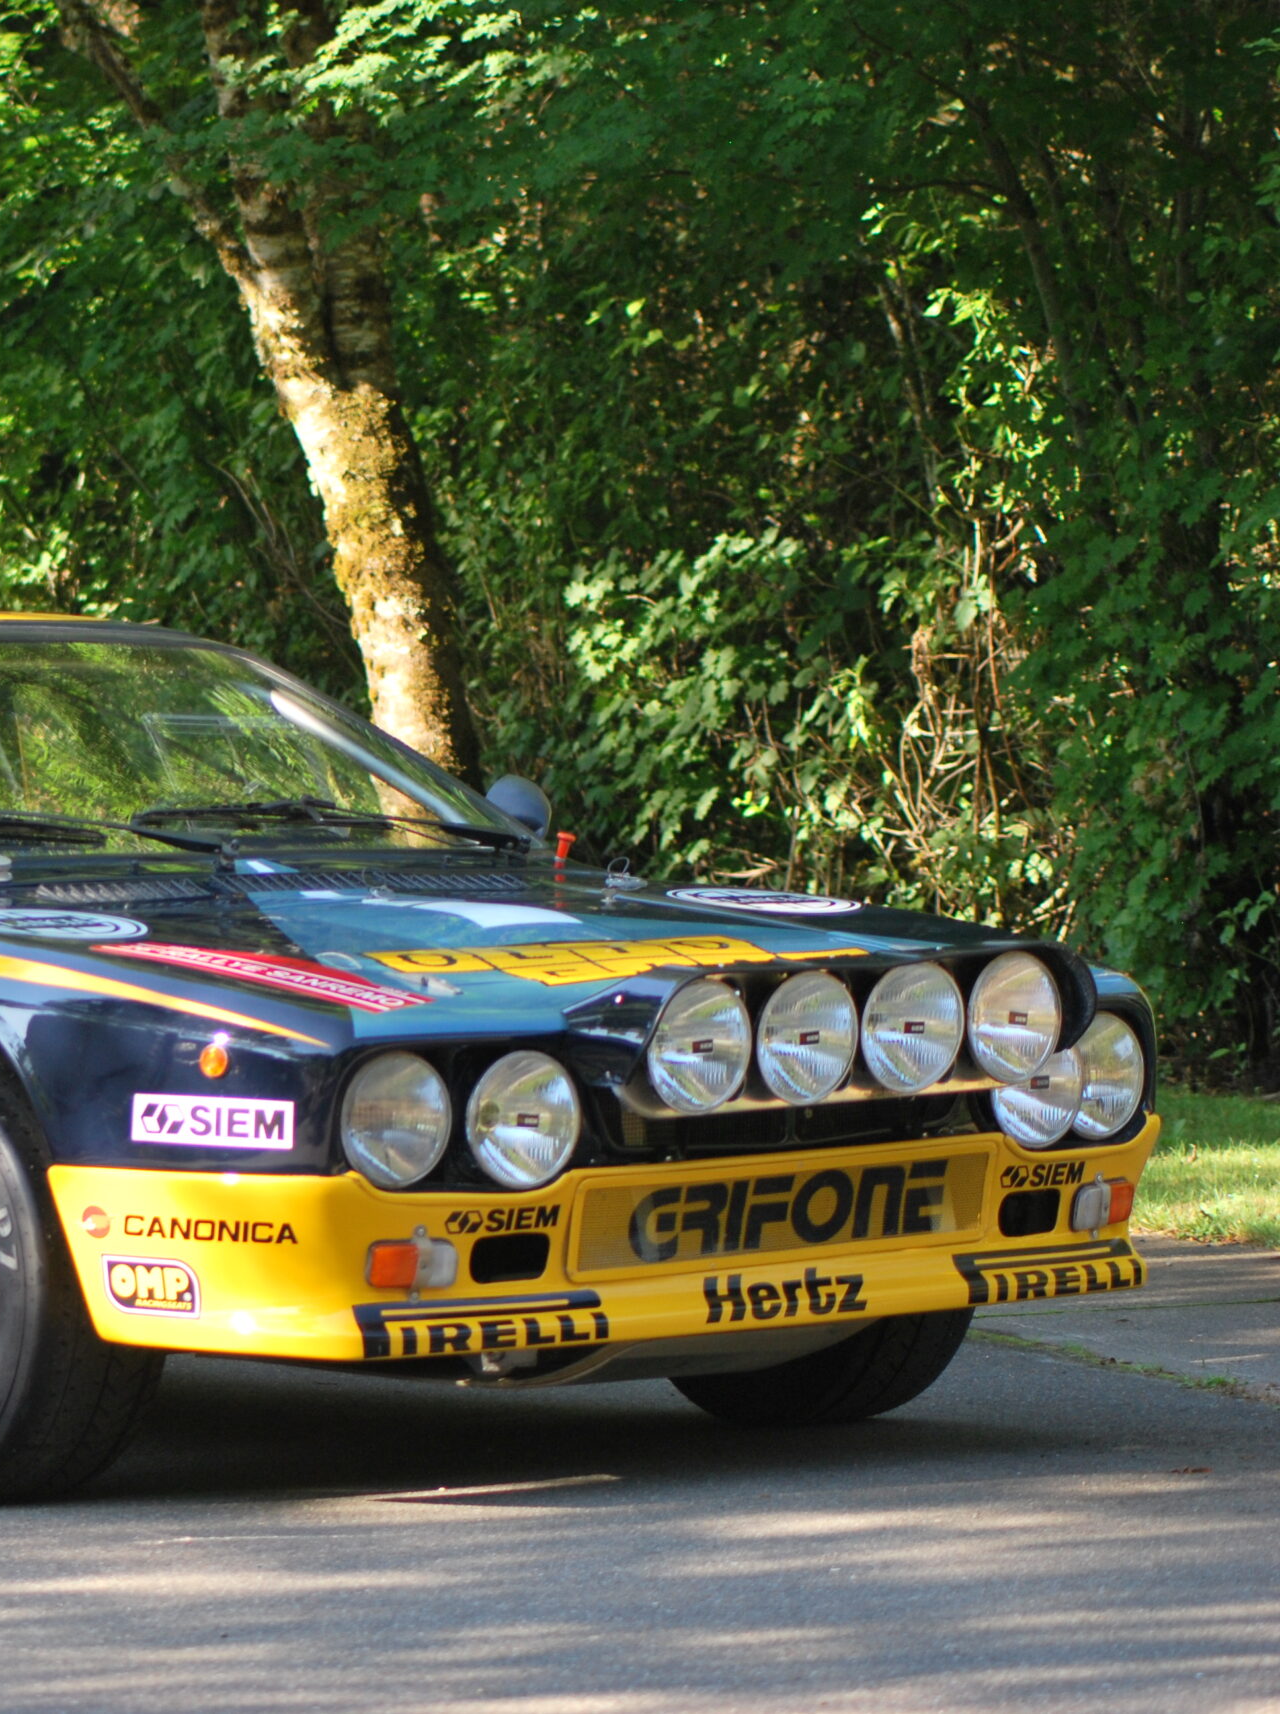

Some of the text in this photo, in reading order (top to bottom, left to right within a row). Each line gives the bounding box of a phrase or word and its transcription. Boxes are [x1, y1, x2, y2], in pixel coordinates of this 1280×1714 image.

[266, 969, 405, 1007] SANREMO
[190, 1106, 286, 1140] SIEM
[1029, 1162, 1086, 1187] SIEM
[124, 1214, 298, 1244] CANONICA
[484, 1205, 561, 1231] SIEM
[628, 1159, 950, 1264] GRIFONE
[952, 1239, 1143, 1305] PIRELLI
[702, 1267, 869, 1325] Hertz
[353, 1289, 610, 1359] PIRELLI
